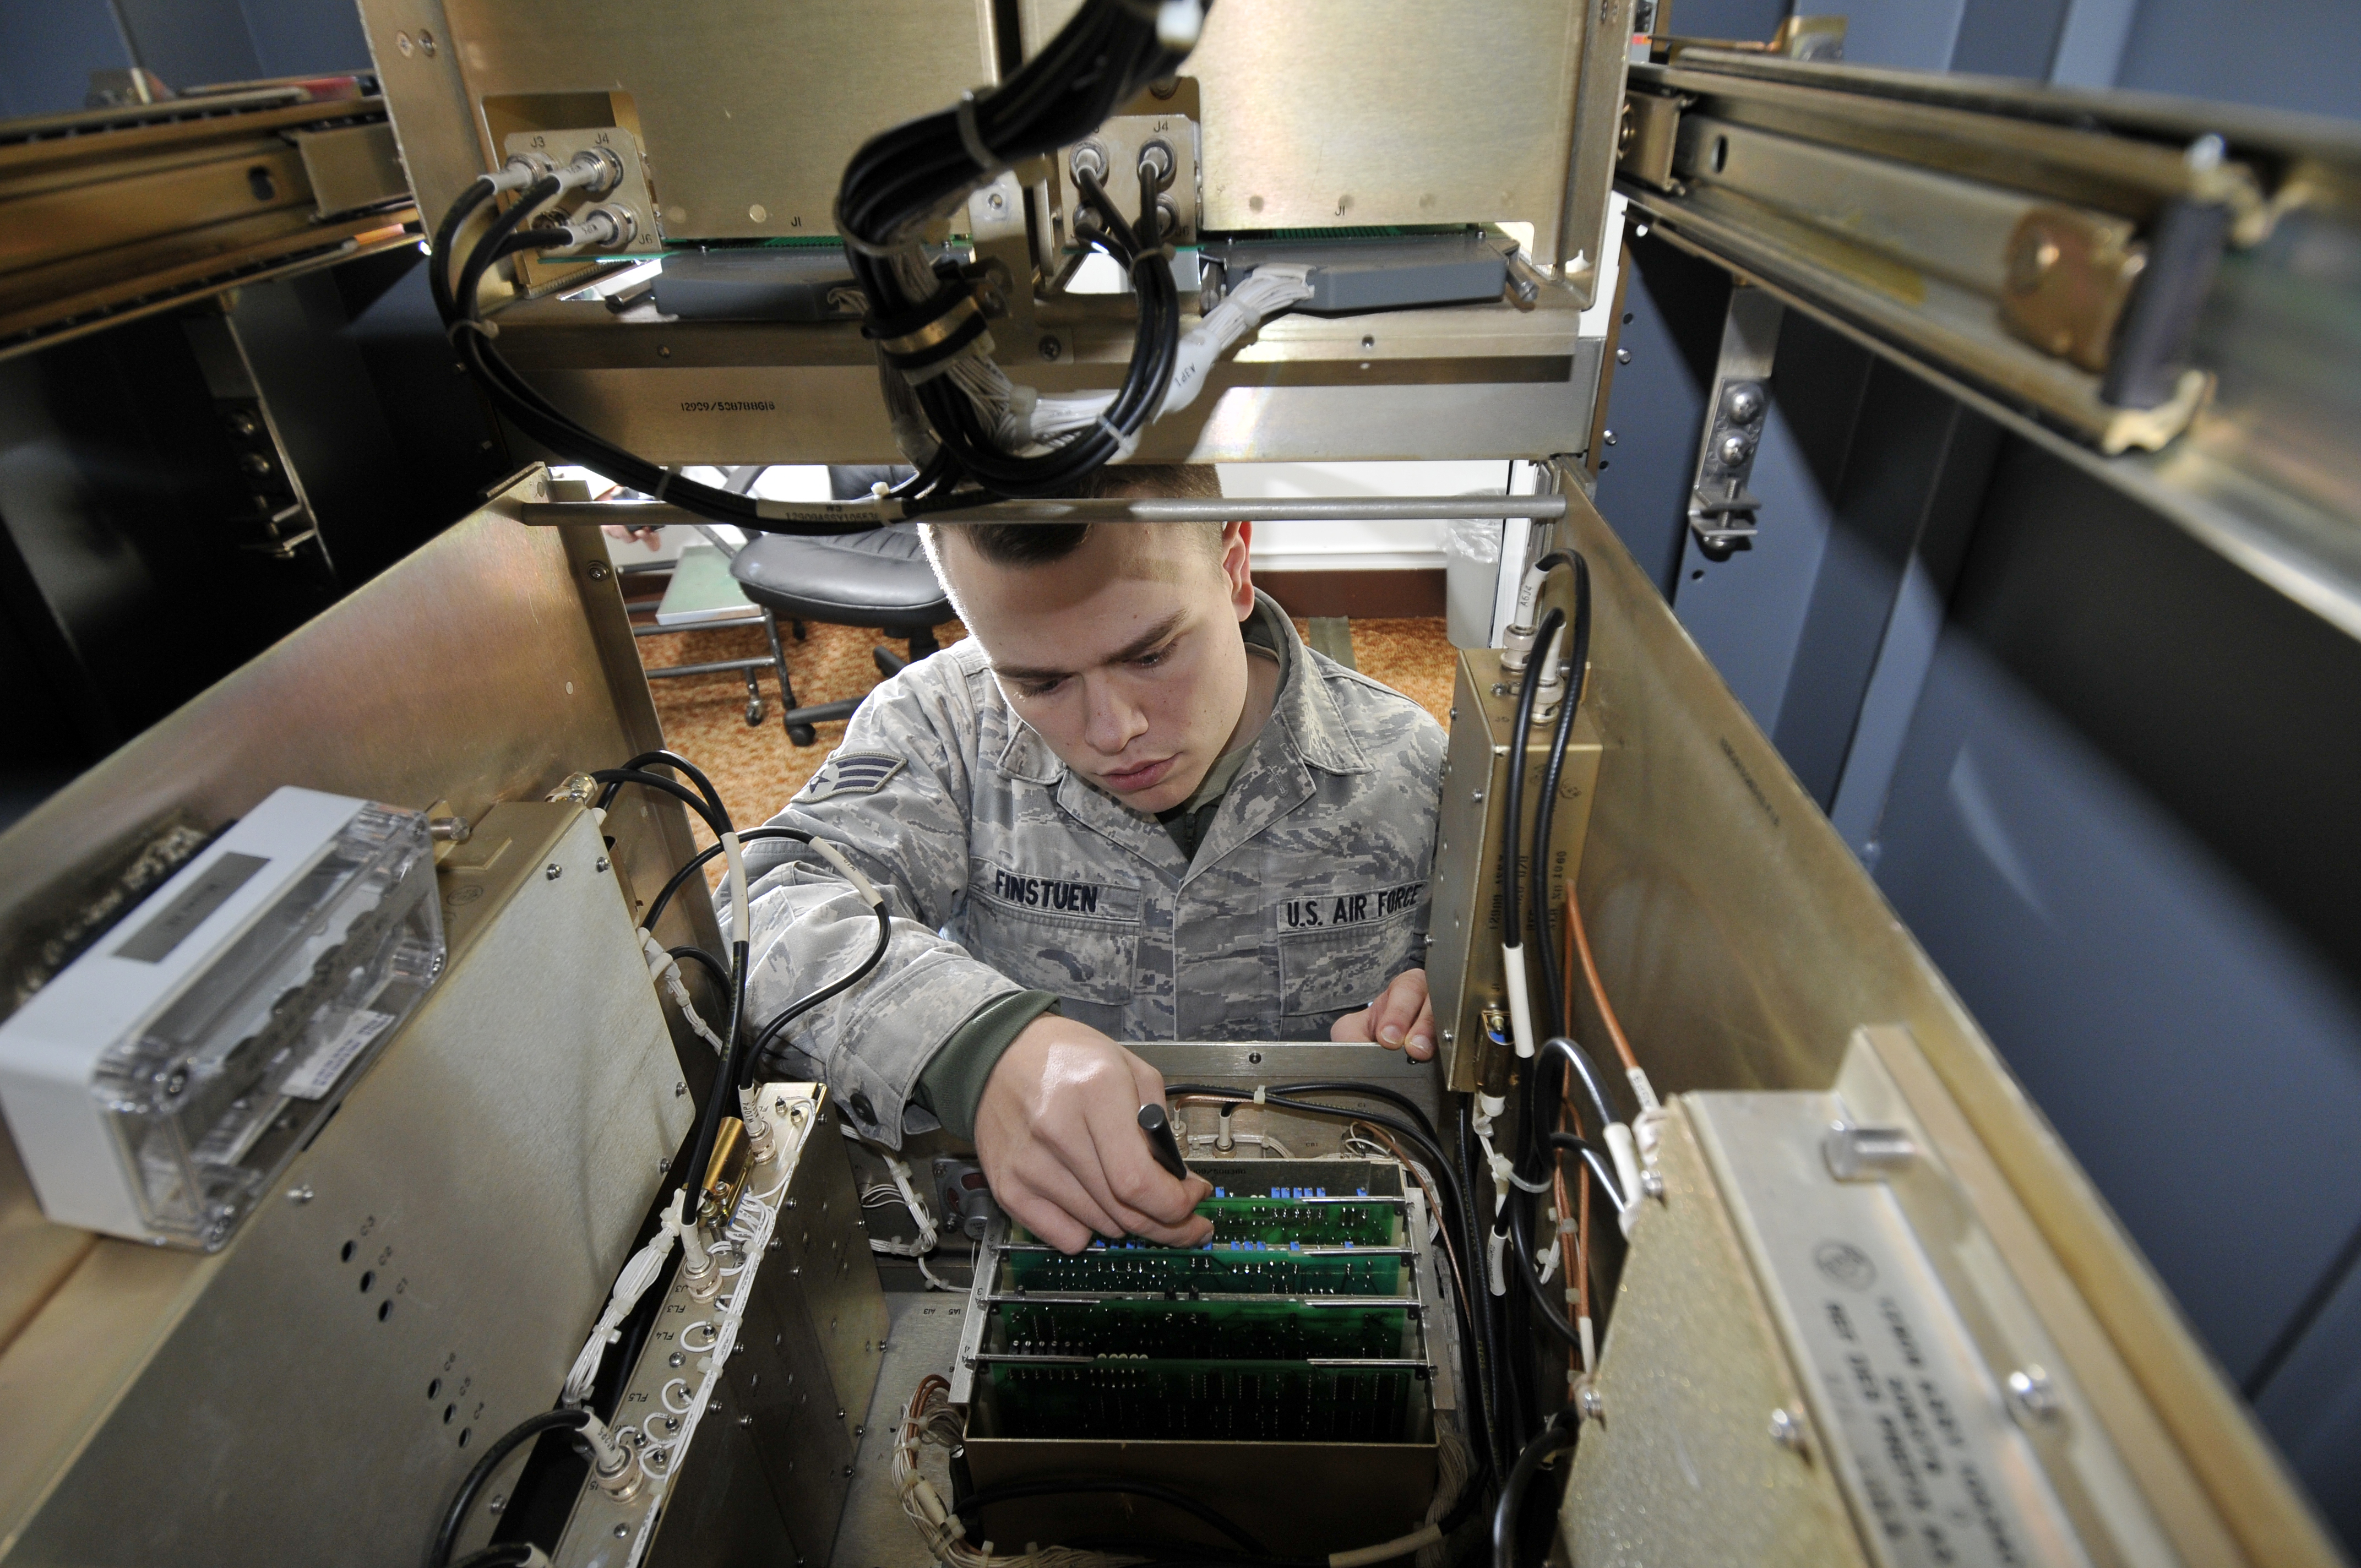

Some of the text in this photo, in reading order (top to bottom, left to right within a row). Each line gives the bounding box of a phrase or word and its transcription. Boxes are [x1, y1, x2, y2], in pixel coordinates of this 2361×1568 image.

[1154, 121, 1168, 133] J4
[531, 136, 545, 148] J3
[596, 133, 609, 145] J4
[1335, 205, 1345, 216] J1
[791, 216, 802, 226] J1
[639, 235, 652, 244] J6
[1174, 362, 1196, 387] A3P1
[1520, 585, 1533, 607] A6J4
[994, 870, 1098, 913] FINSTUEN
[1287, 884, 1419, 928] U.S. AIR FORCE
[743, 1101, 754, 1124] W10P4
[666, 1305, 686, 1313] FL3
[656, 1331, 674, 1341] FL4
[628, 1393, 649, 1402] FL5
